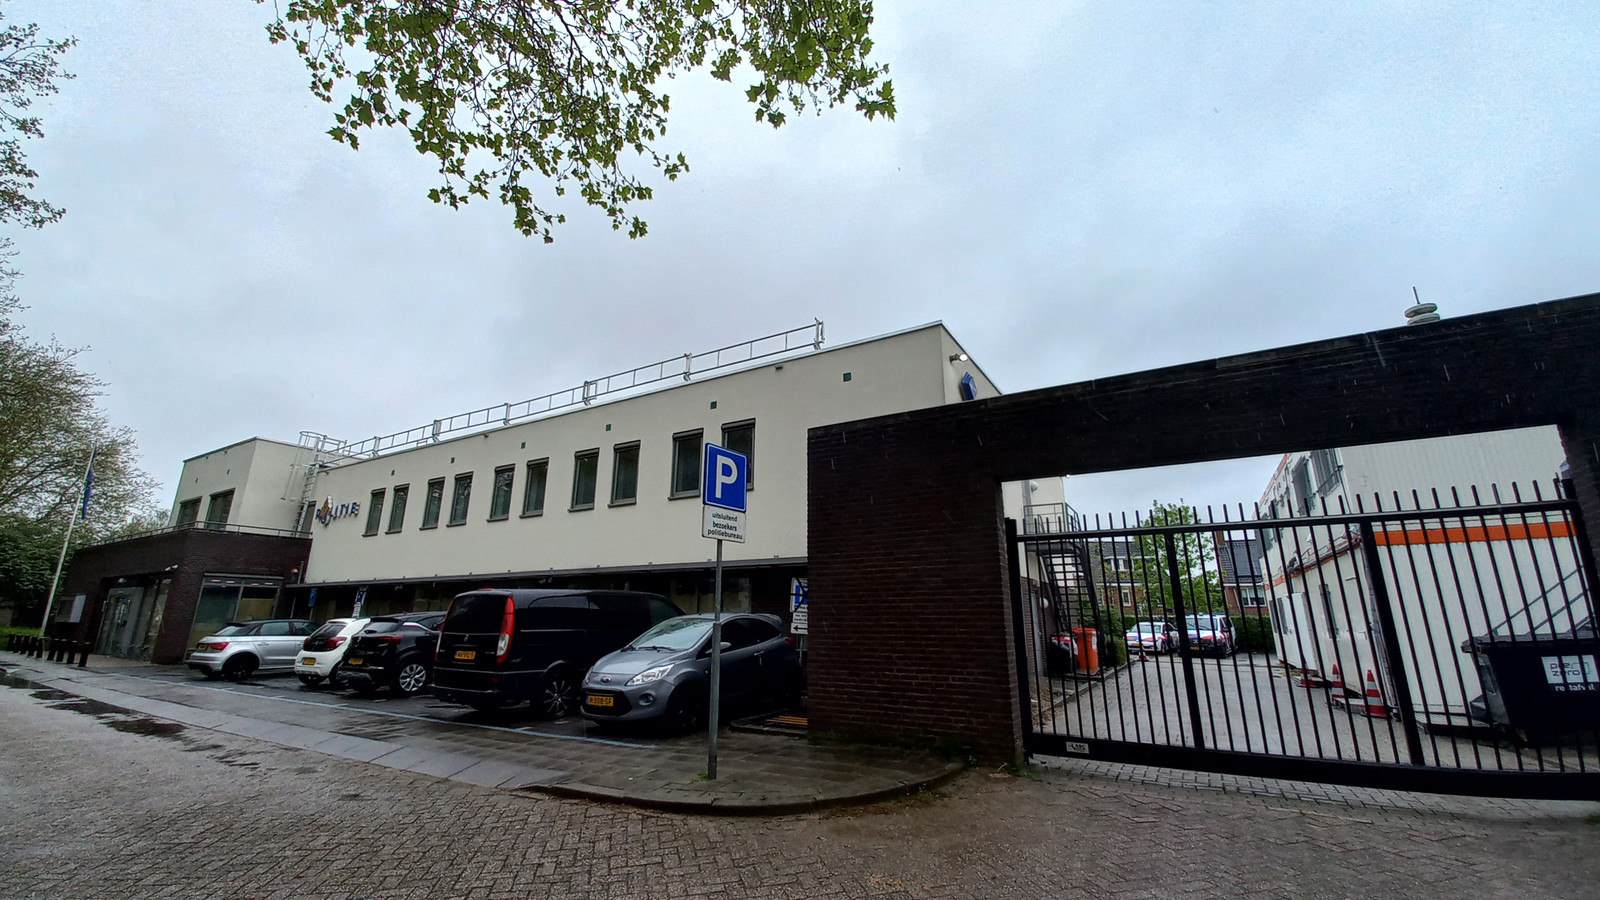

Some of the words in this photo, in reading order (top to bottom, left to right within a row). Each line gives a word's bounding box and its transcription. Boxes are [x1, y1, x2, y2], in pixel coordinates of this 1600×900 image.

[715, 454, 738, 499] P
[712, 512, 737, 521] uitsluitend
[713, 521, 737, 531] bezoekers
[708, 529, 742, 539] politiebureau
